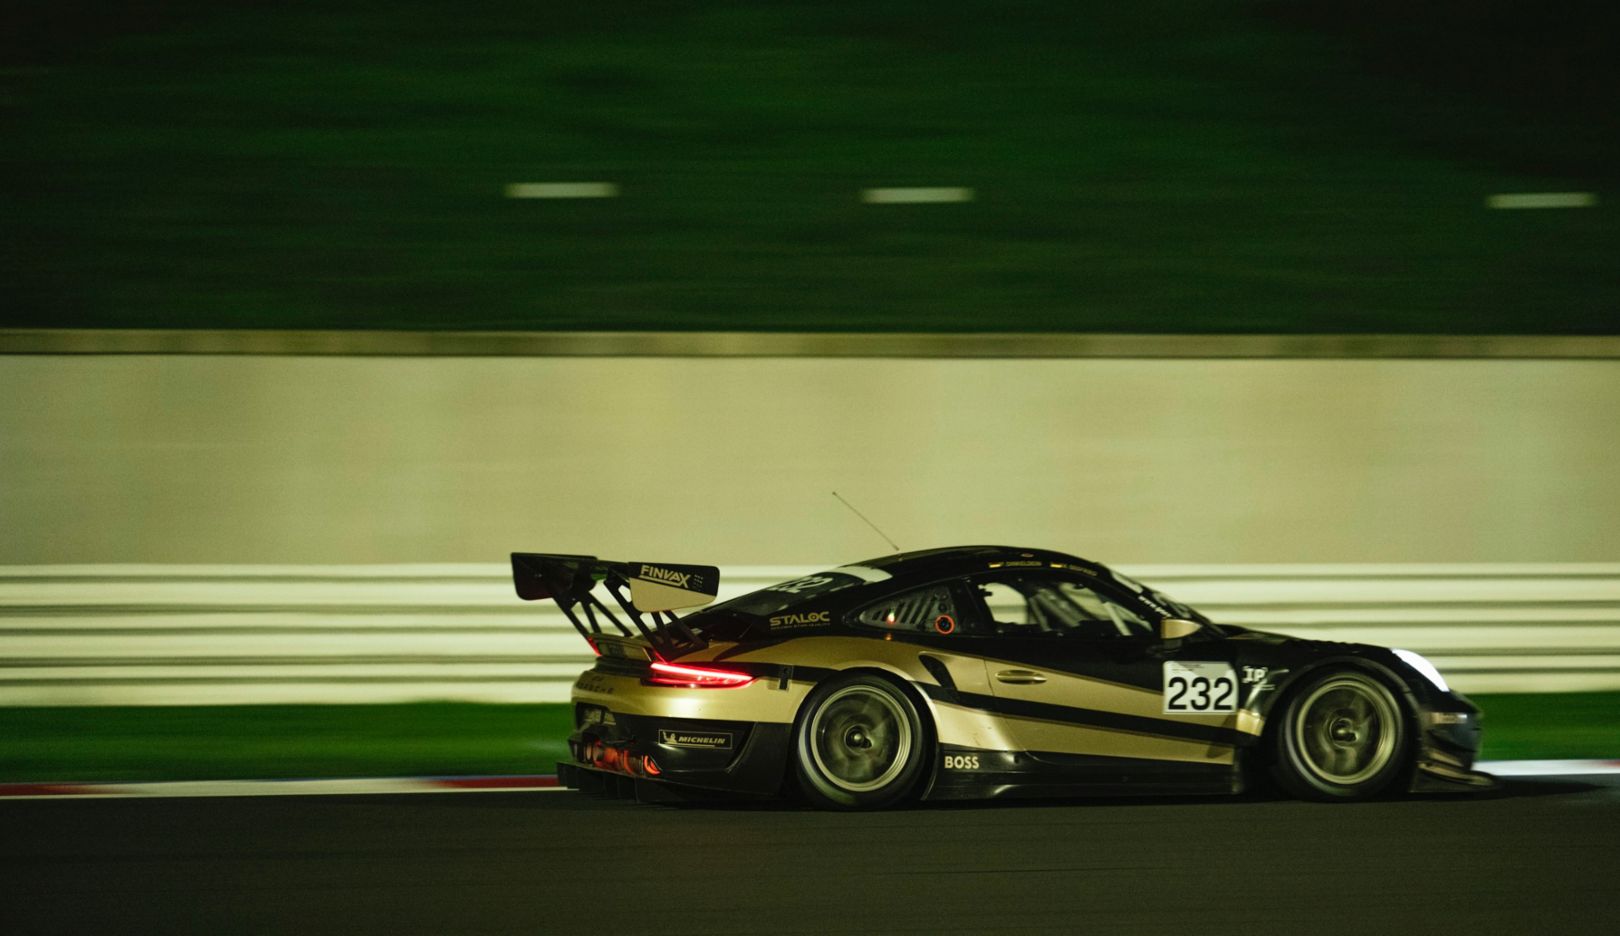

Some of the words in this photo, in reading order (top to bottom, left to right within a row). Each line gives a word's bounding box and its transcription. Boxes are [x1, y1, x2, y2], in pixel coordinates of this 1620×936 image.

[639, 564, 691, 589] FINVAX
[769, 611, 830, 627] STALOC
[1167, 676, 1233, 711] 232
[678, 736, 726, 744] MICHELIN
[944, 755, 980, 769] BOSS
